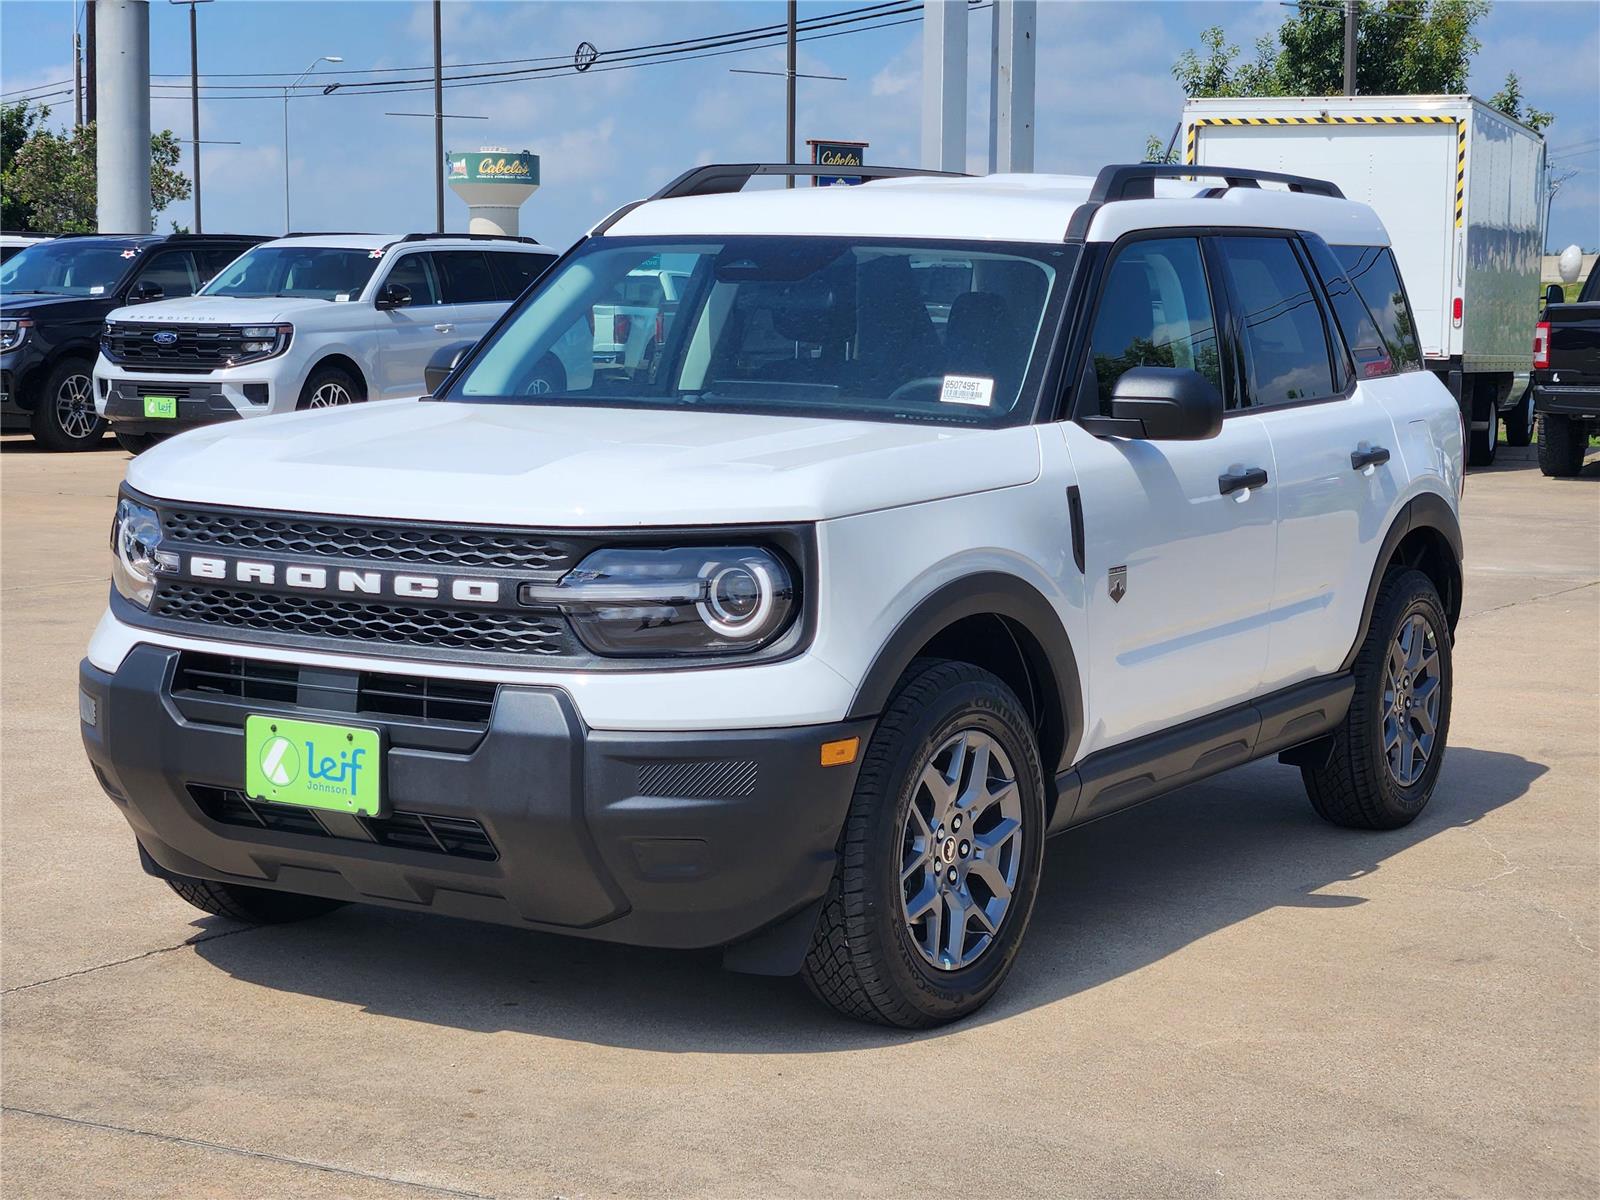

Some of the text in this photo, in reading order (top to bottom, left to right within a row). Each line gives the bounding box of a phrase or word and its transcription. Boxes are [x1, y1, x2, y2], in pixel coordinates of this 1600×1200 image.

[821, 150, 860, 166] Cabela's
[190, 556, 499, 602] BRONCO
[307, 780, 348, 796] Johnson
